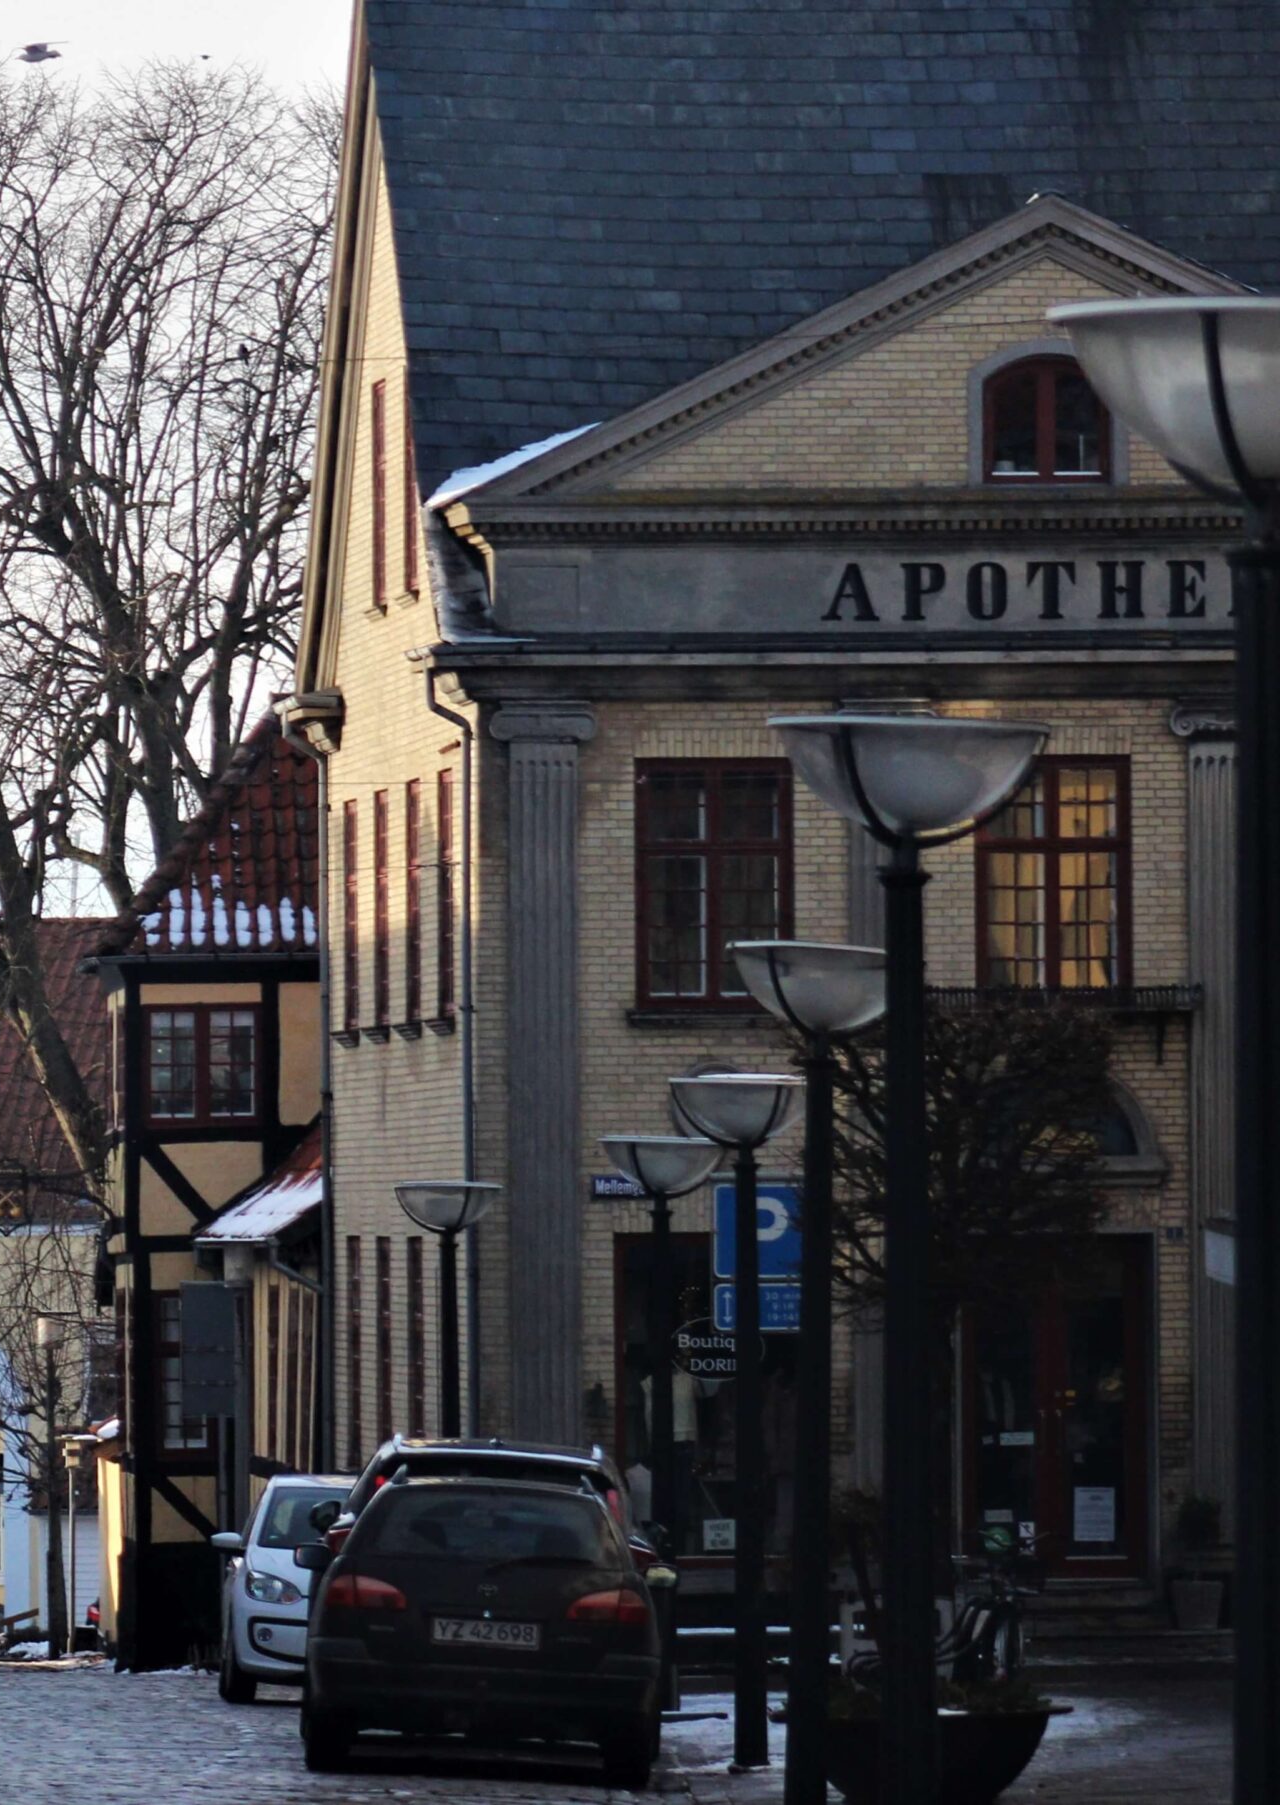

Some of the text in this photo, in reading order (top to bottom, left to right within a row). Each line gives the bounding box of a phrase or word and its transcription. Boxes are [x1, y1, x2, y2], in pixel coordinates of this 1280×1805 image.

[820, 560, 1236, 621] APOTHE
[677, 1333, 736, 1352] Boutiq
[438, 1621, 535, 1643] YZ 42 698
